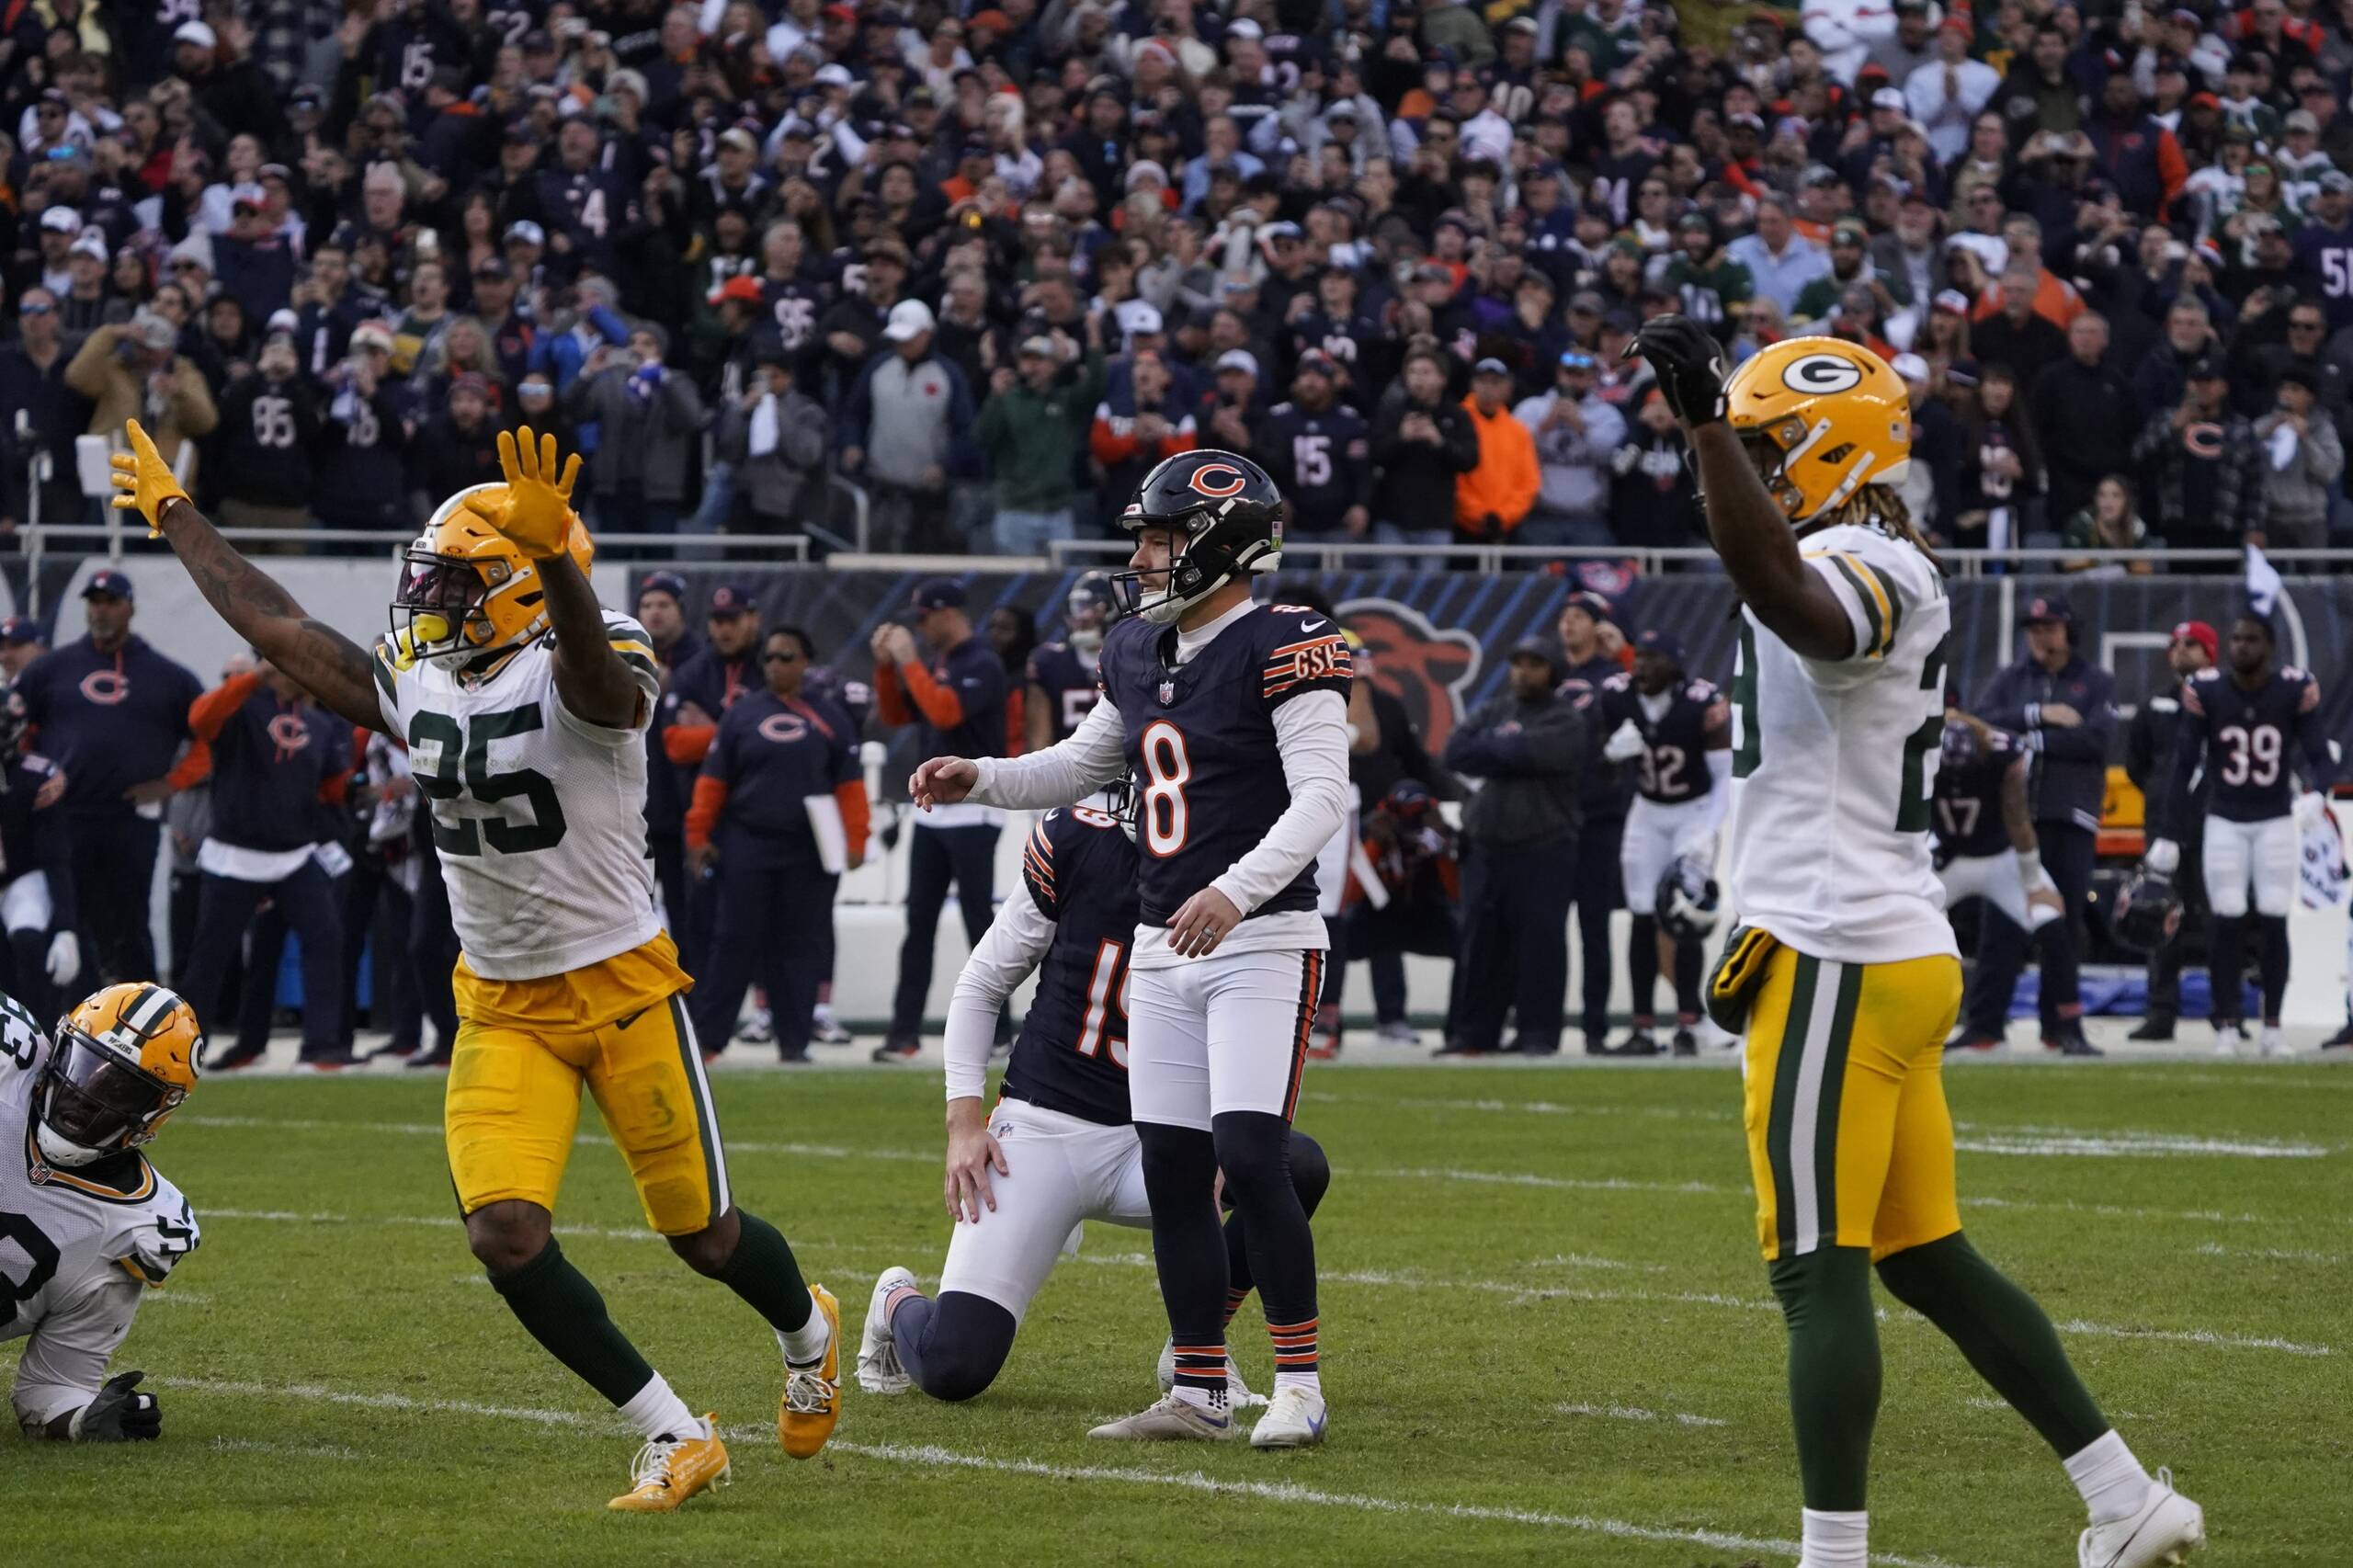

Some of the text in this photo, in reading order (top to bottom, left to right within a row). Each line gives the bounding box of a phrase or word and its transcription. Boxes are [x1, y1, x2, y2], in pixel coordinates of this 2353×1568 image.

[1782, 353, 1861, 395] G
[1188, 463, 1246, 497] C
[1291, 436, 1333, 487] 15
[757, 713, 808, 743] C
[408, 700, 567, 857] 25
[2220, 725, 2282, 788] 39
[1142, 719, 1191, 858] 8
